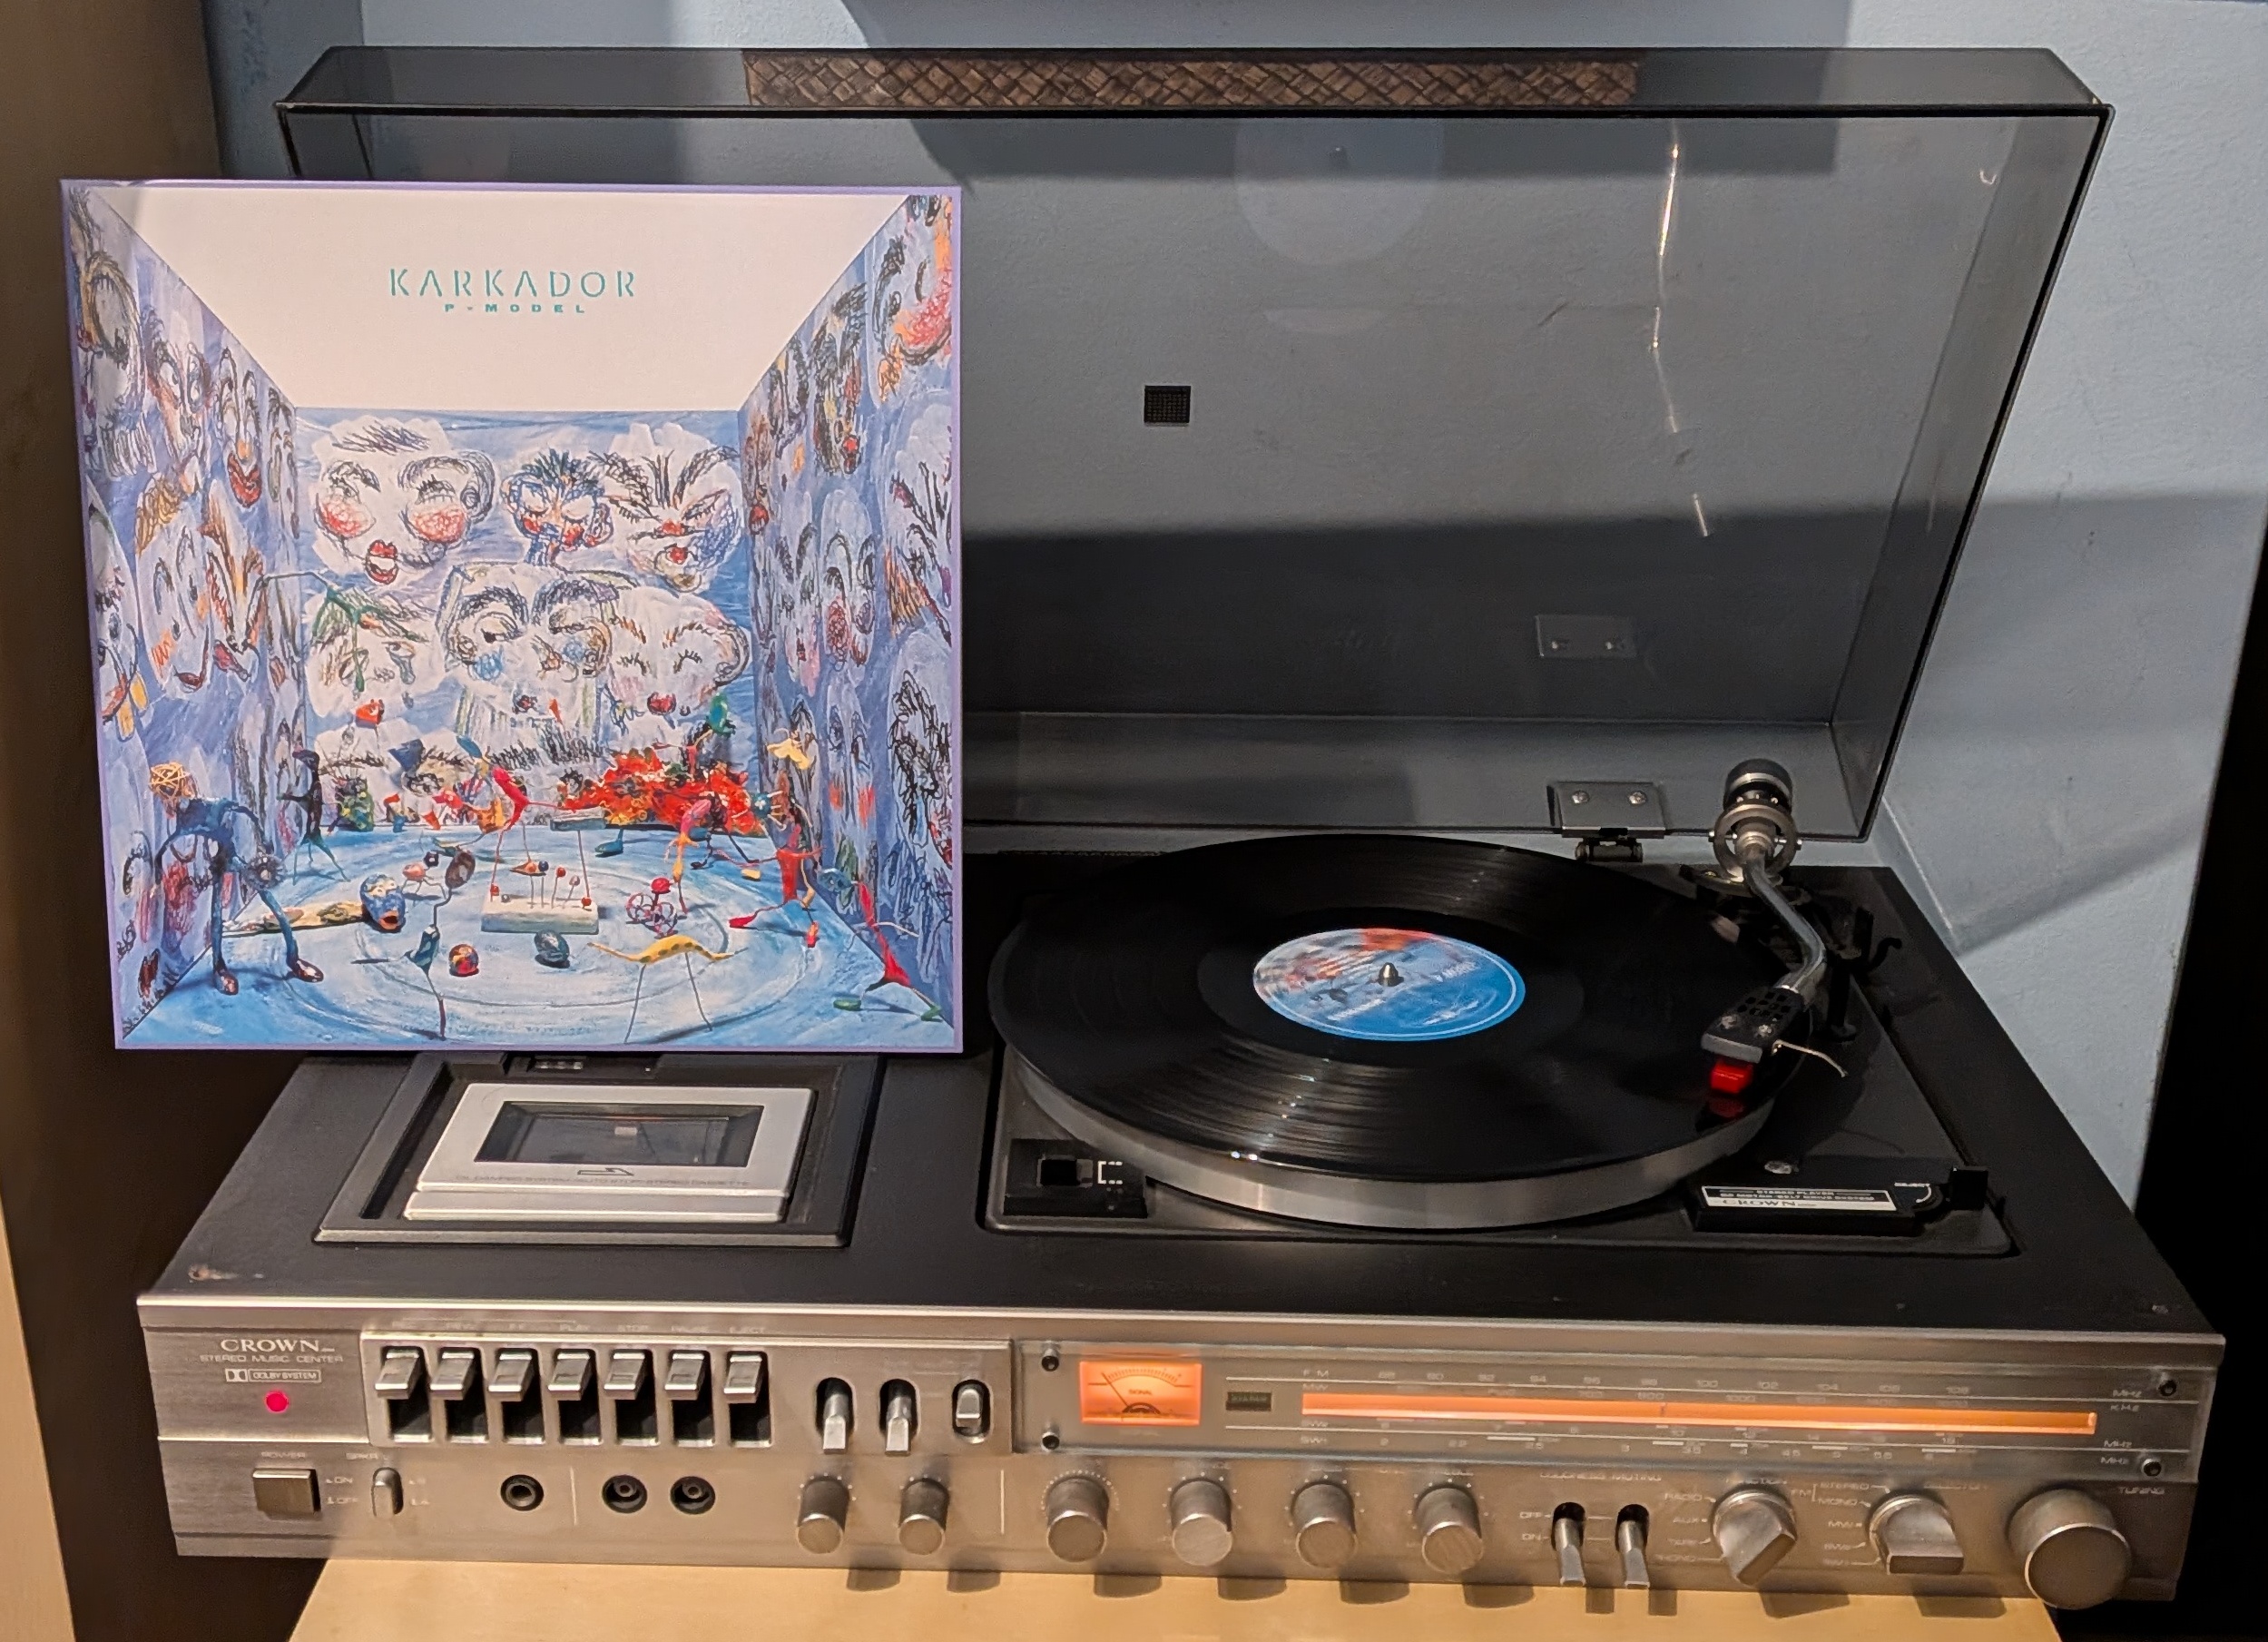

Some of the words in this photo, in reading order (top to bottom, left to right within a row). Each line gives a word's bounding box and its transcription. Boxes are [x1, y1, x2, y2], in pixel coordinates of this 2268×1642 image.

[389, 268, 634, 298] KARKADOR
[444, 303, 585, 314] P-MODEL
[221, 1339, 319, 1352] CROWN
